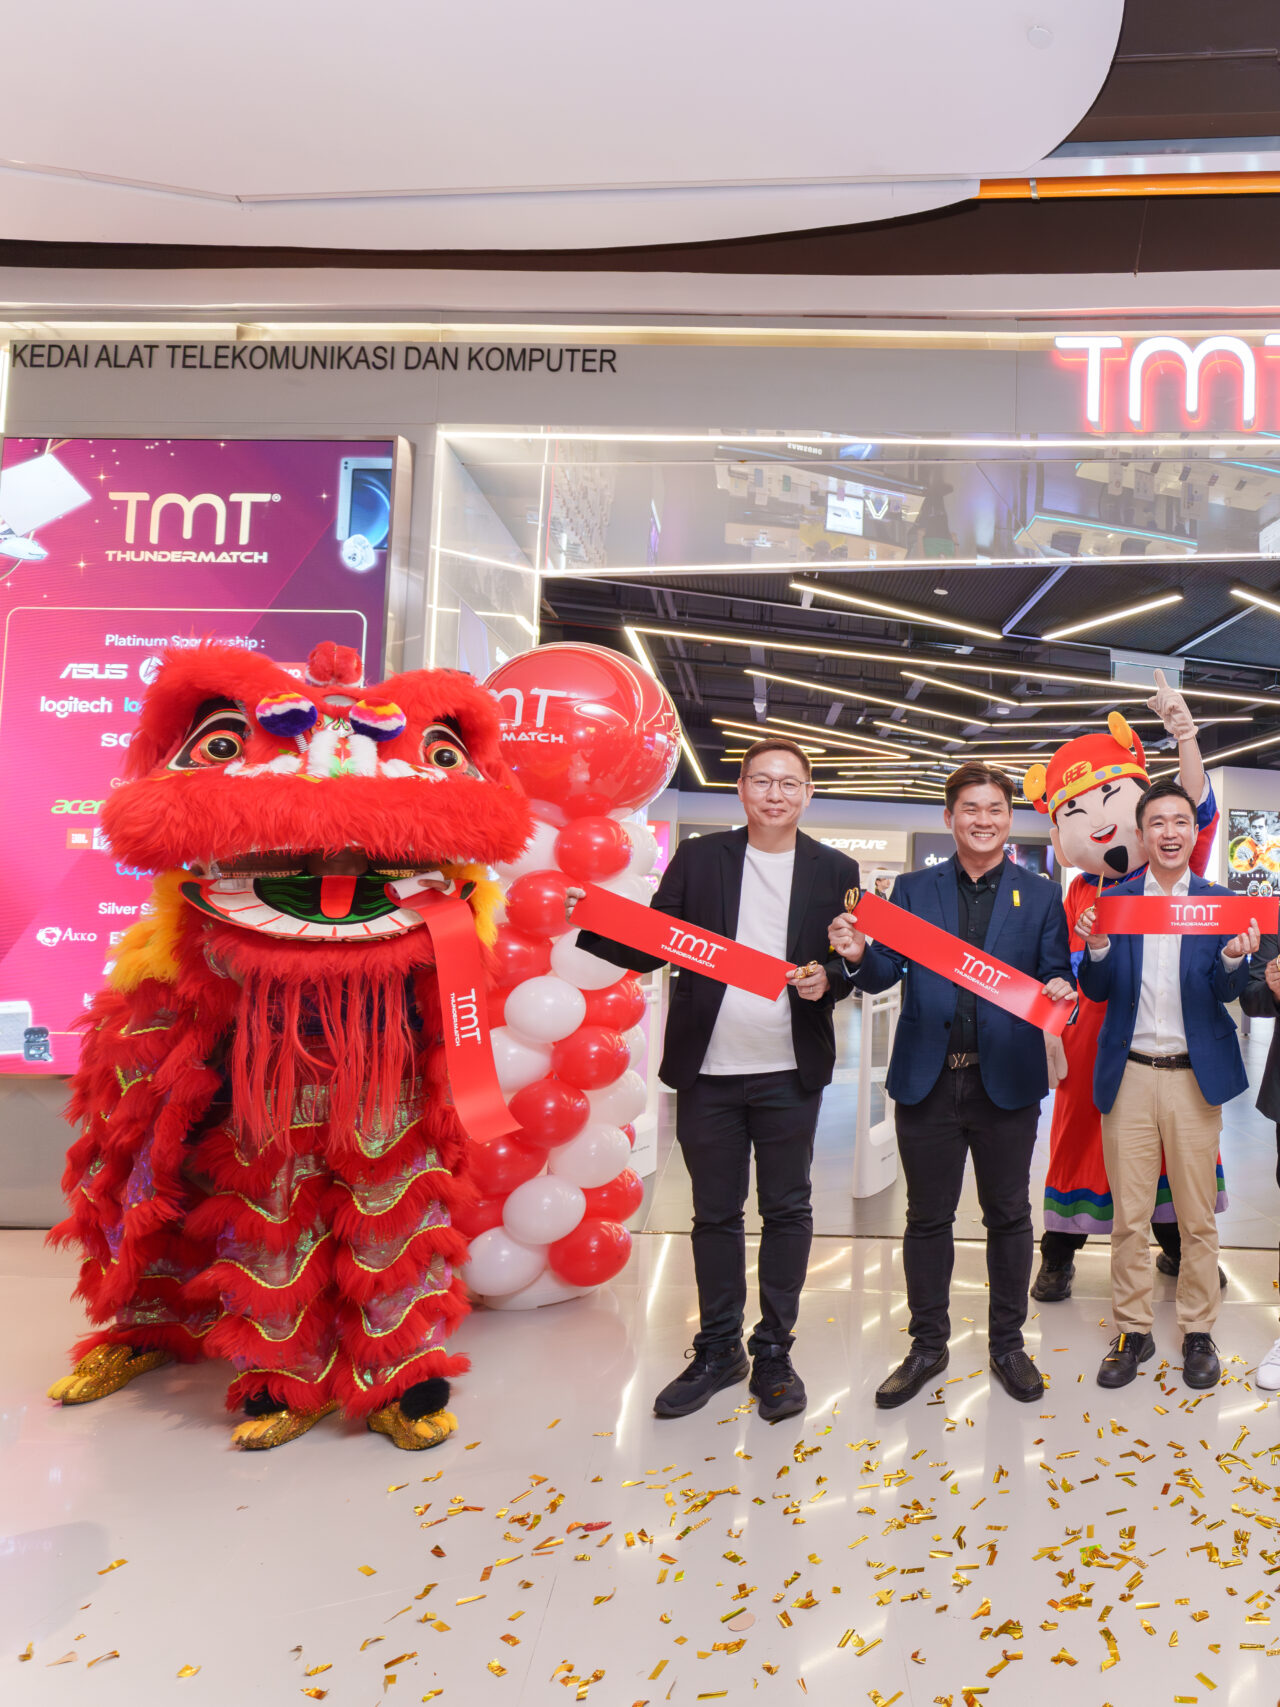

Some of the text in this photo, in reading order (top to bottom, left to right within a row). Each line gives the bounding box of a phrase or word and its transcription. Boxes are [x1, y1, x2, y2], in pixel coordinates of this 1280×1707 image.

[12, 344, 617, 373] KEDAI ALAT TELEKOMUNIKASI DAN KOMPUTER
[105, 550, 268, 563] THUNDERMATCH
[105, 633, 168, 647] Platinum
[60, 663, 128, 679] ASUS
[40, 695, 112, 718] logitech
[51, 799, 105, 814] acer
[98, 902, 139, 915] Silver
[661, 944, 716, 969] THUNDERMATCH
[954, 967, 1000, 995] THUNDERMATCH
